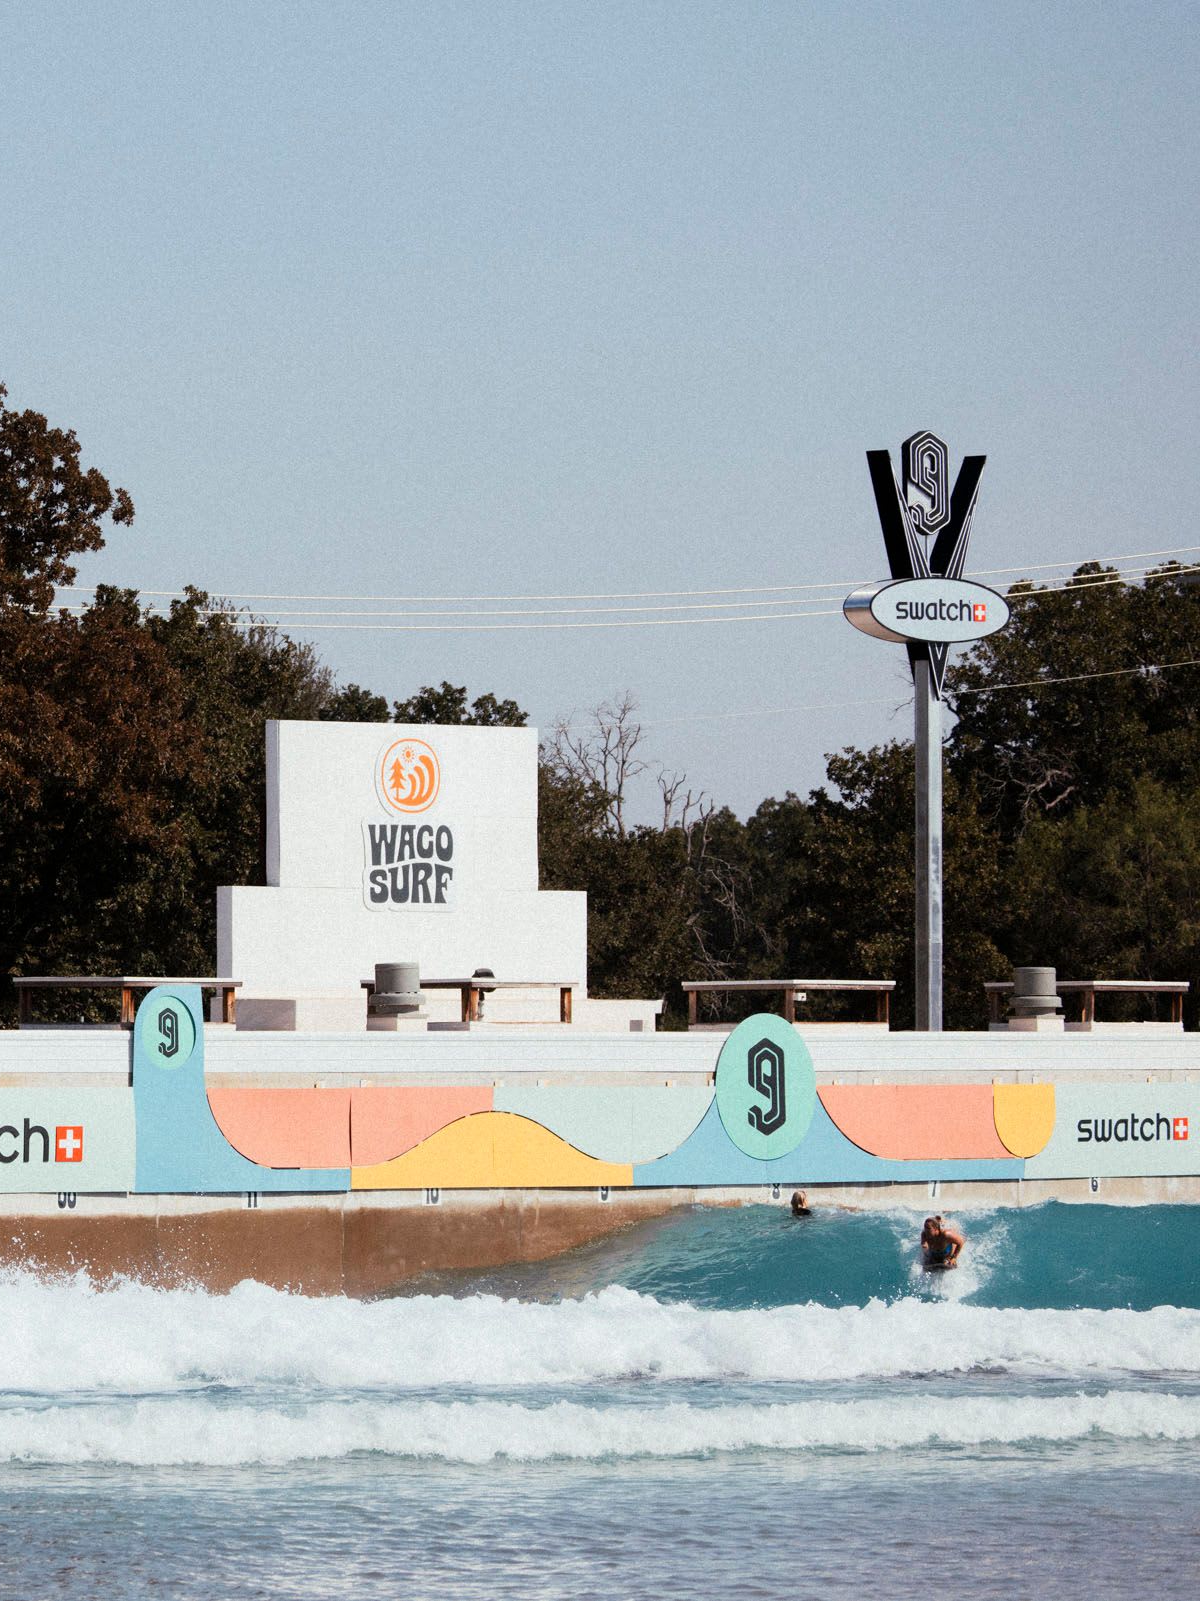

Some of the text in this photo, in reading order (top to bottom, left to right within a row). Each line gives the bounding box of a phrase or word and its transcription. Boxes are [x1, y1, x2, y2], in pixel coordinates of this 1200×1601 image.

[895, 598, 972, 622] swatch
[367, 823, 454, 866] WACO
[368, 862, 454, 904] SURF
[1077, 1112, 1171, 1143] swatch
